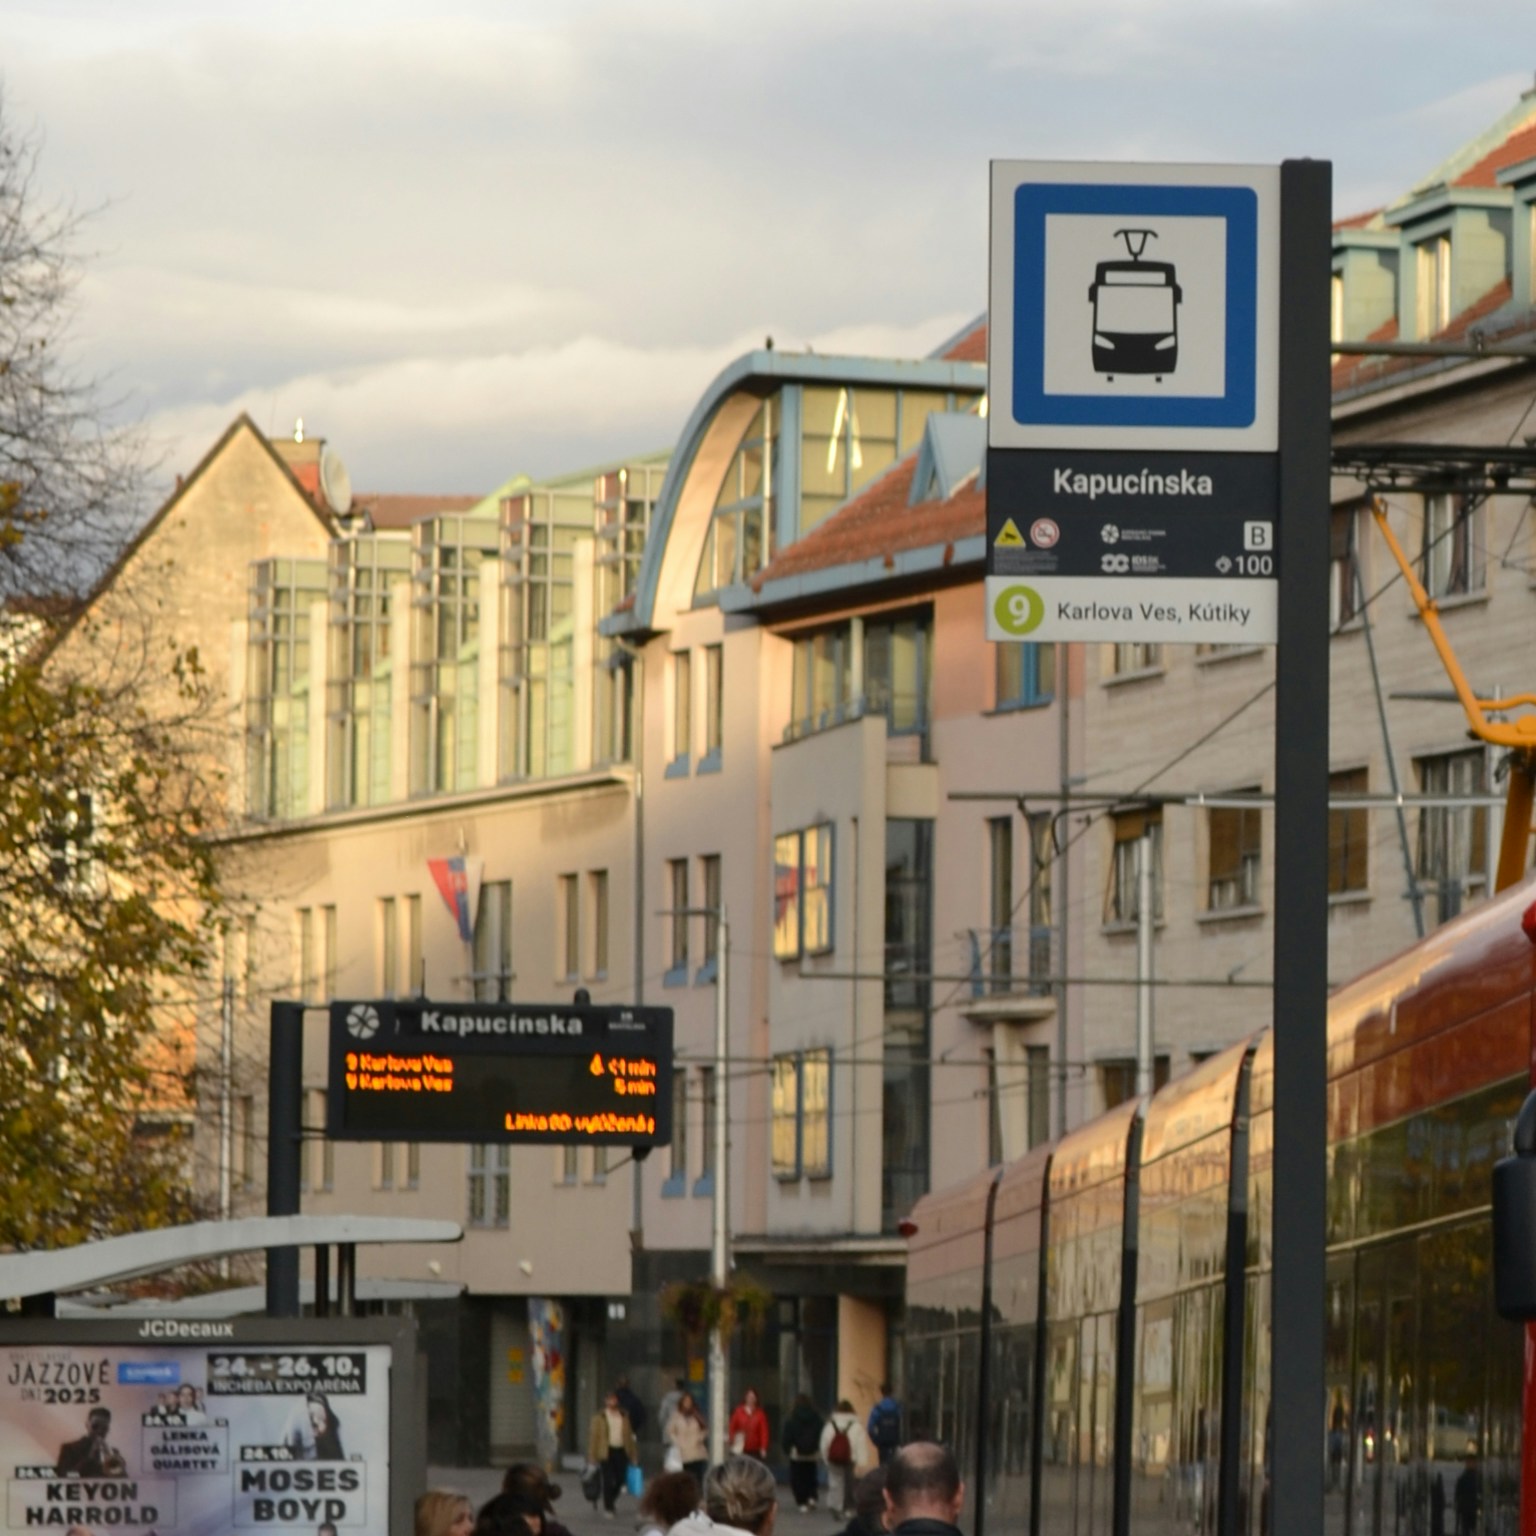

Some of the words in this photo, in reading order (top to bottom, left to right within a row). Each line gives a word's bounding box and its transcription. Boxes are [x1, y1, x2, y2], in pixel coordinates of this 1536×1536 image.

[1053, 468, 1213, 500] Kapucínska
[1251, 526, 1265, 546] B
[1235, 555, 1273, 575] 100
[1008, 594, 1031, 627] 9
[1057, 602, 1133, 621] Karlova
[1140, 604, 1182, 624] Ves,
[1188, 603, 1251, 626] Kútiky
[421, 1011, 583, 1037] Kapucínska
[627, 1058, 656, 1077] min
[627, 1078, 656, 1096] min
[139, 1319, 234, 1339] JCDecaux
[8, 1357, 111, 1386] JAZZOVÉ
[213, 1356, 255, 1377] 24.
[277, 1356, 319, 1377] 26.
[322, 1356, 362, 1377] 10.
[213, 1378, 274, 1393] INCHEBA
[275, 1378, 313, 1392] EXPO
[313, 1376, 361, 1392] ARÉNA
[44, 1388, 101, 1405] 2025
[162, 1430, 209, 1442] LENKA
[152, 1459, 218, 1470] QUARTET
[240, 1468, 360, 1493] MOSES
[46, 1482, 139, 1502] KEYON
[25, 1505, 159, 1526] HARROLD
[252, 1497, 347, 1523] BOYD
